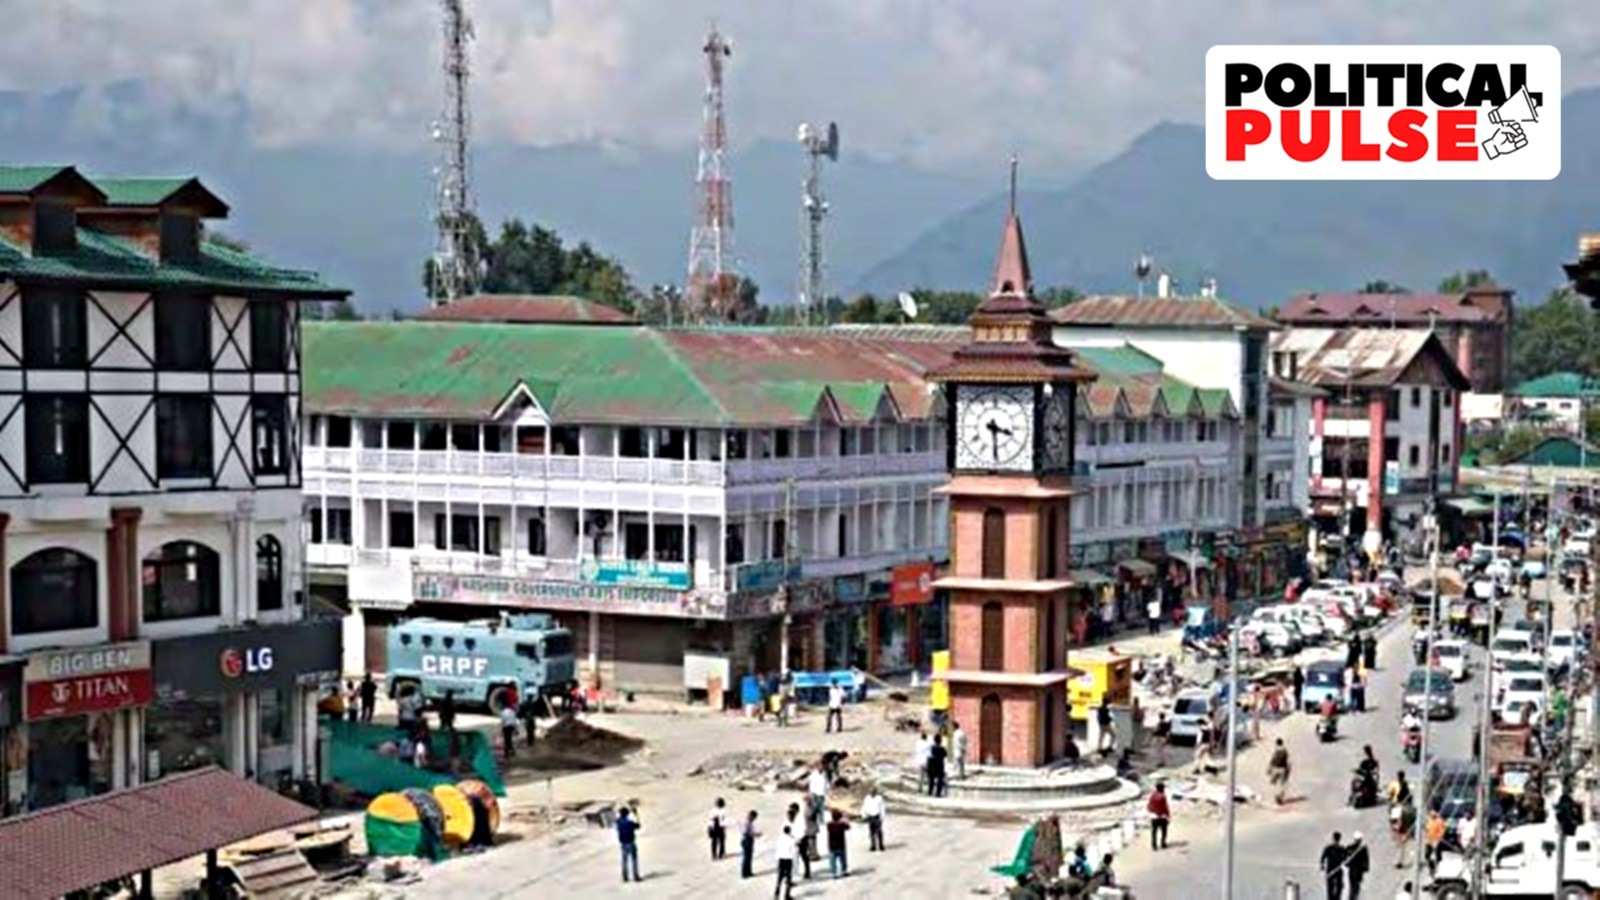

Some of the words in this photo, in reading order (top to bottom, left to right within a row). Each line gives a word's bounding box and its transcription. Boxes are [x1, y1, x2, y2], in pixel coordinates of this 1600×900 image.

[513, 580, 586, 599] GOVERNMENT
[49, 655, 85, 675] BIG
[92, 649, 131, 670] BEN
[246, 647, 273, 672] LG
[421, 654, 489, 676] CRPF
[75, 676, 129, 699] TITAN
